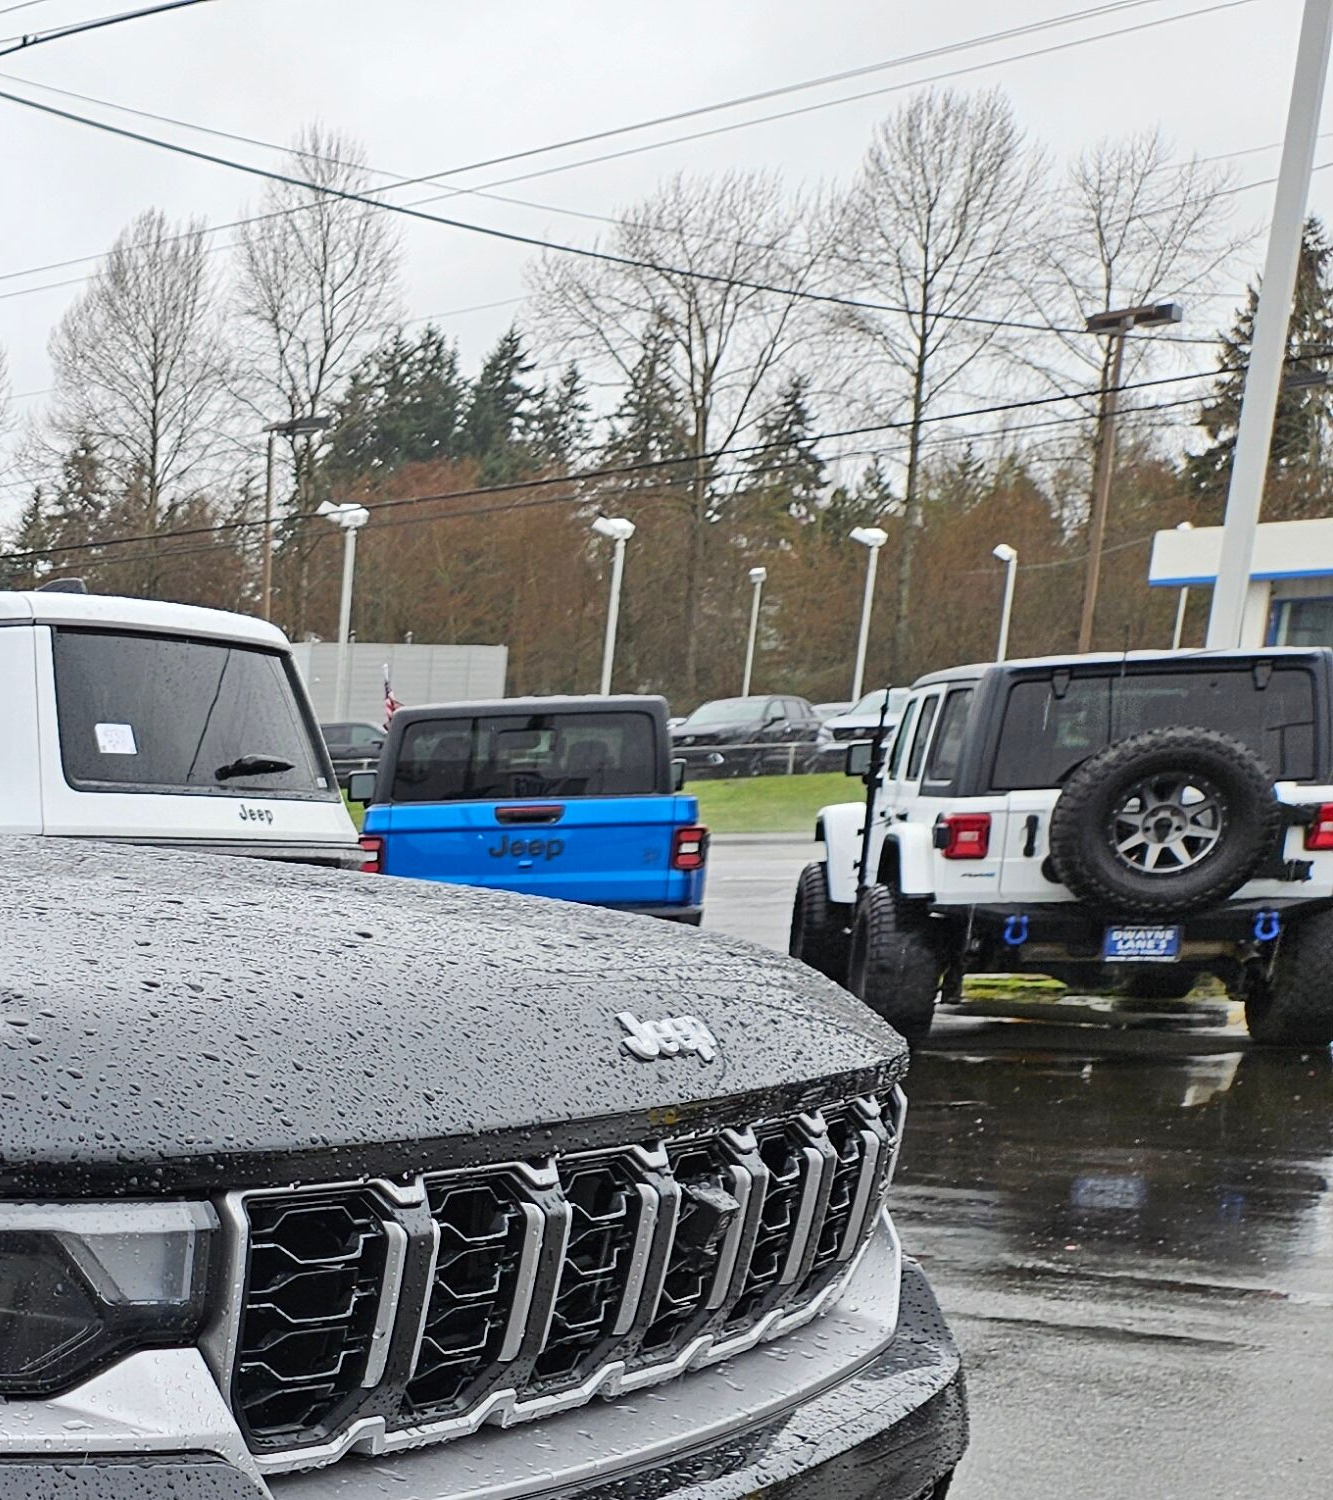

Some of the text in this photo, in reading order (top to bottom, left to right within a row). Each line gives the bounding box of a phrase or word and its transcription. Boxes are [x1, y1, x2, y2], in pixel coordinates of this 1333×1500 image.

[239, 804, 274, 825] Jeep
[489, 834, 565, 861] Jeep
[1111, 930, 1175, 941] DWAYNE
[614, 1011, 717, 1061] Jeep
